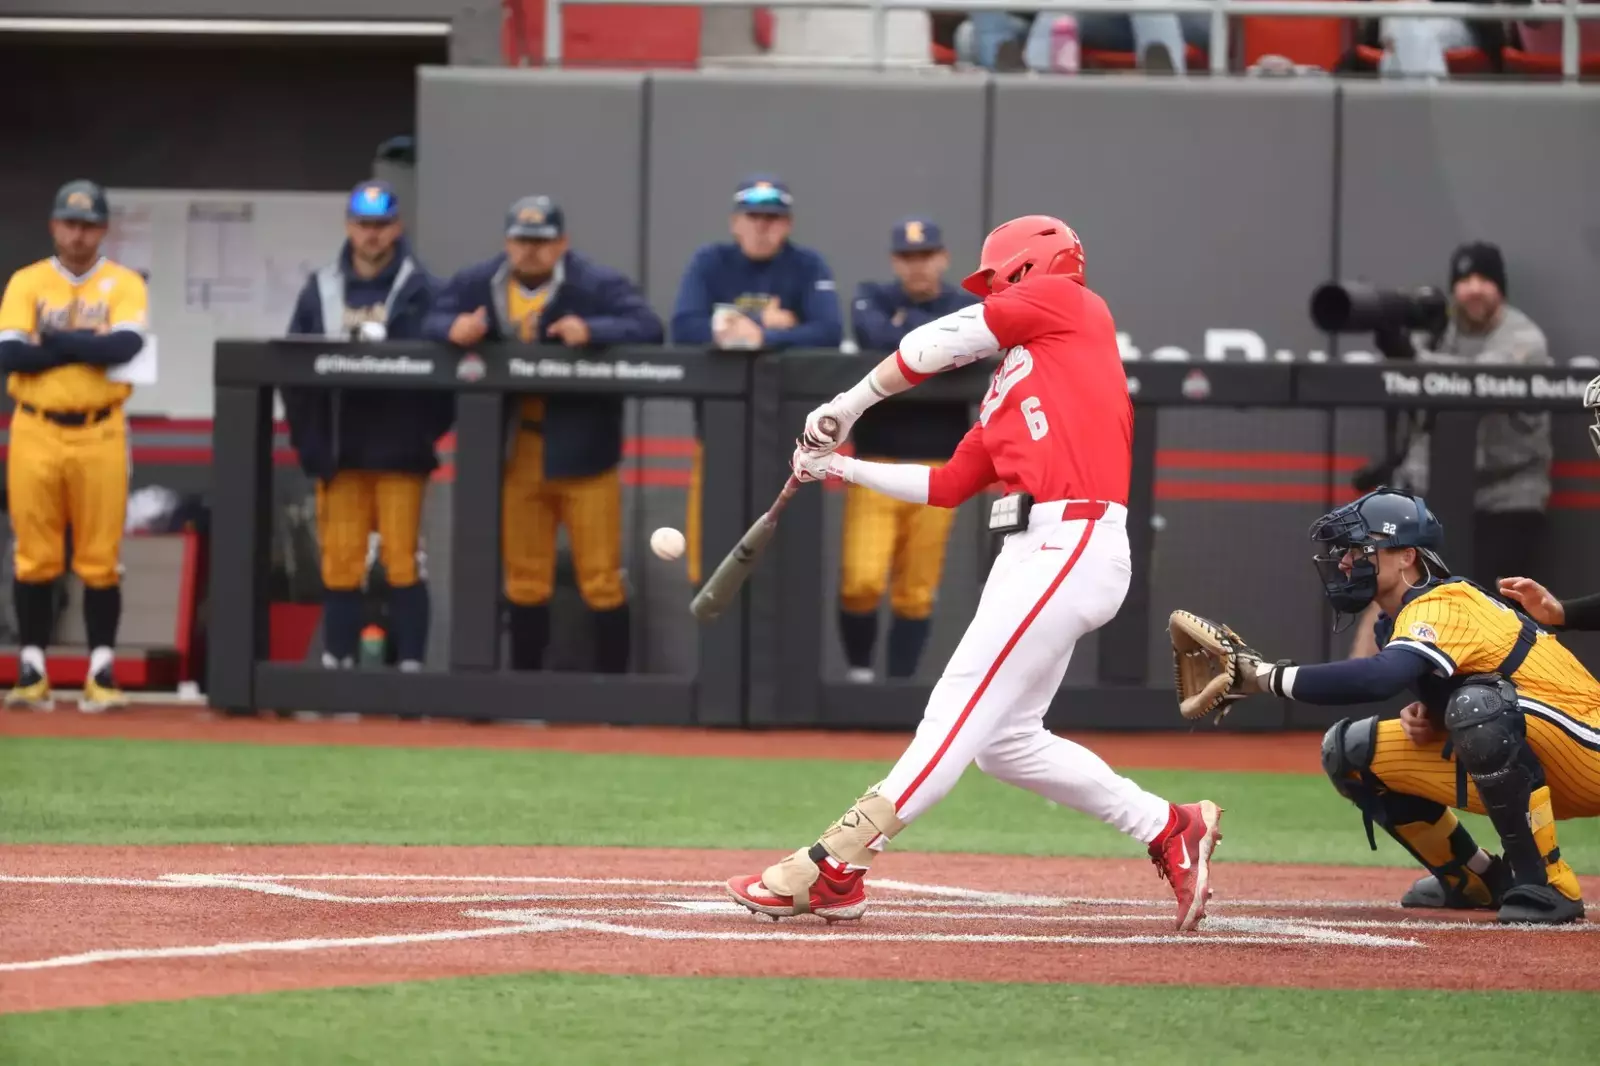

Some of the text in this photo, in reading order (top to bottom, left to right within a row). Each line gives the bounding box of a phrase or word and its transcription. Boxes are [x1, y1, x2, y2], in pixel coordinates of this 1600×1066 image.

[508, 358, 684, 382] The Ohio State Buckeyes
[1382, 371, 1588, 398] The Ohio State Bucke
[1021, 396, 1049, 441] 6
[1383, 522, 1397, 535] 22
